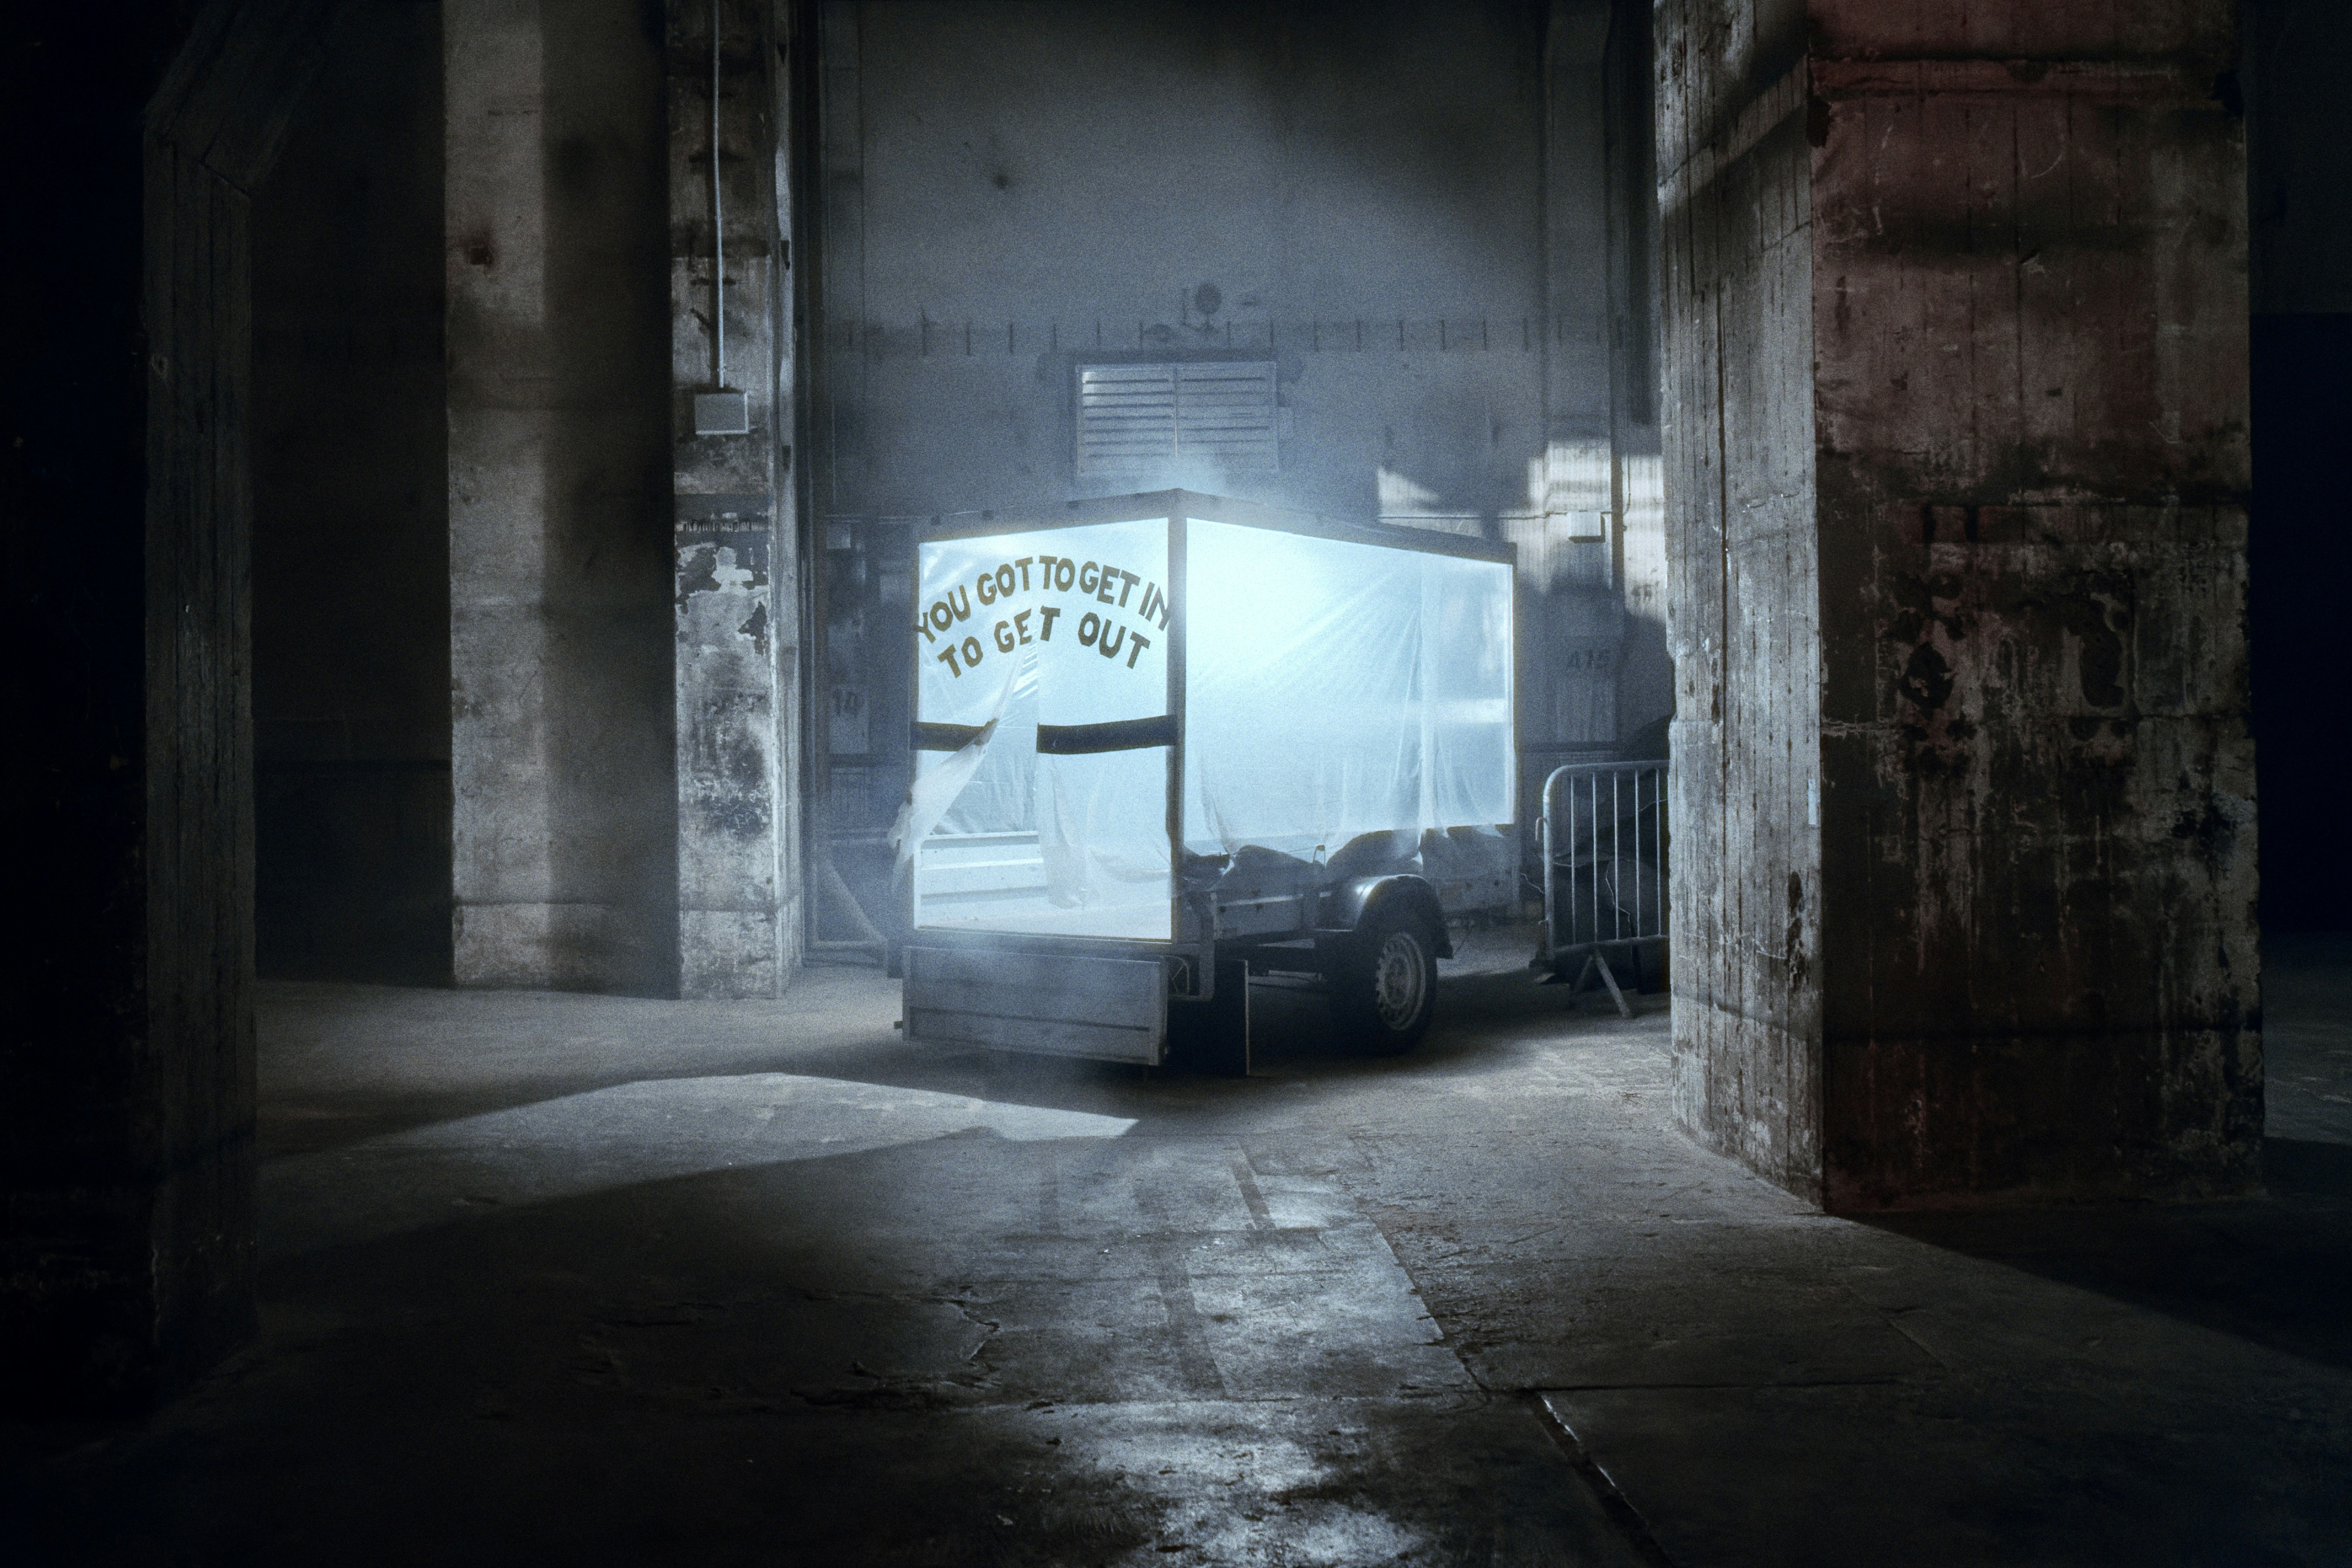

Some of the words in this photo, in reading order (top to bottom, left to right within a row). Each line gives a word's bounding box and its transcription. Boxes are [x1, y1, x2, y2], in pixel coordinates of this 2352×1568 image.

[913, 585, 971, 644] YOU
[976, 557, 1033, 605] GOT
[1039, 555, 1075, 592] TO
[1079, 561, 1140, 608] GET
[1138, 581, 1171, 631] IN
[937, 636, 984, 679] TO
[994, 605, 1060, 653] GET
[1078, 612, 1151, 669] OUT
